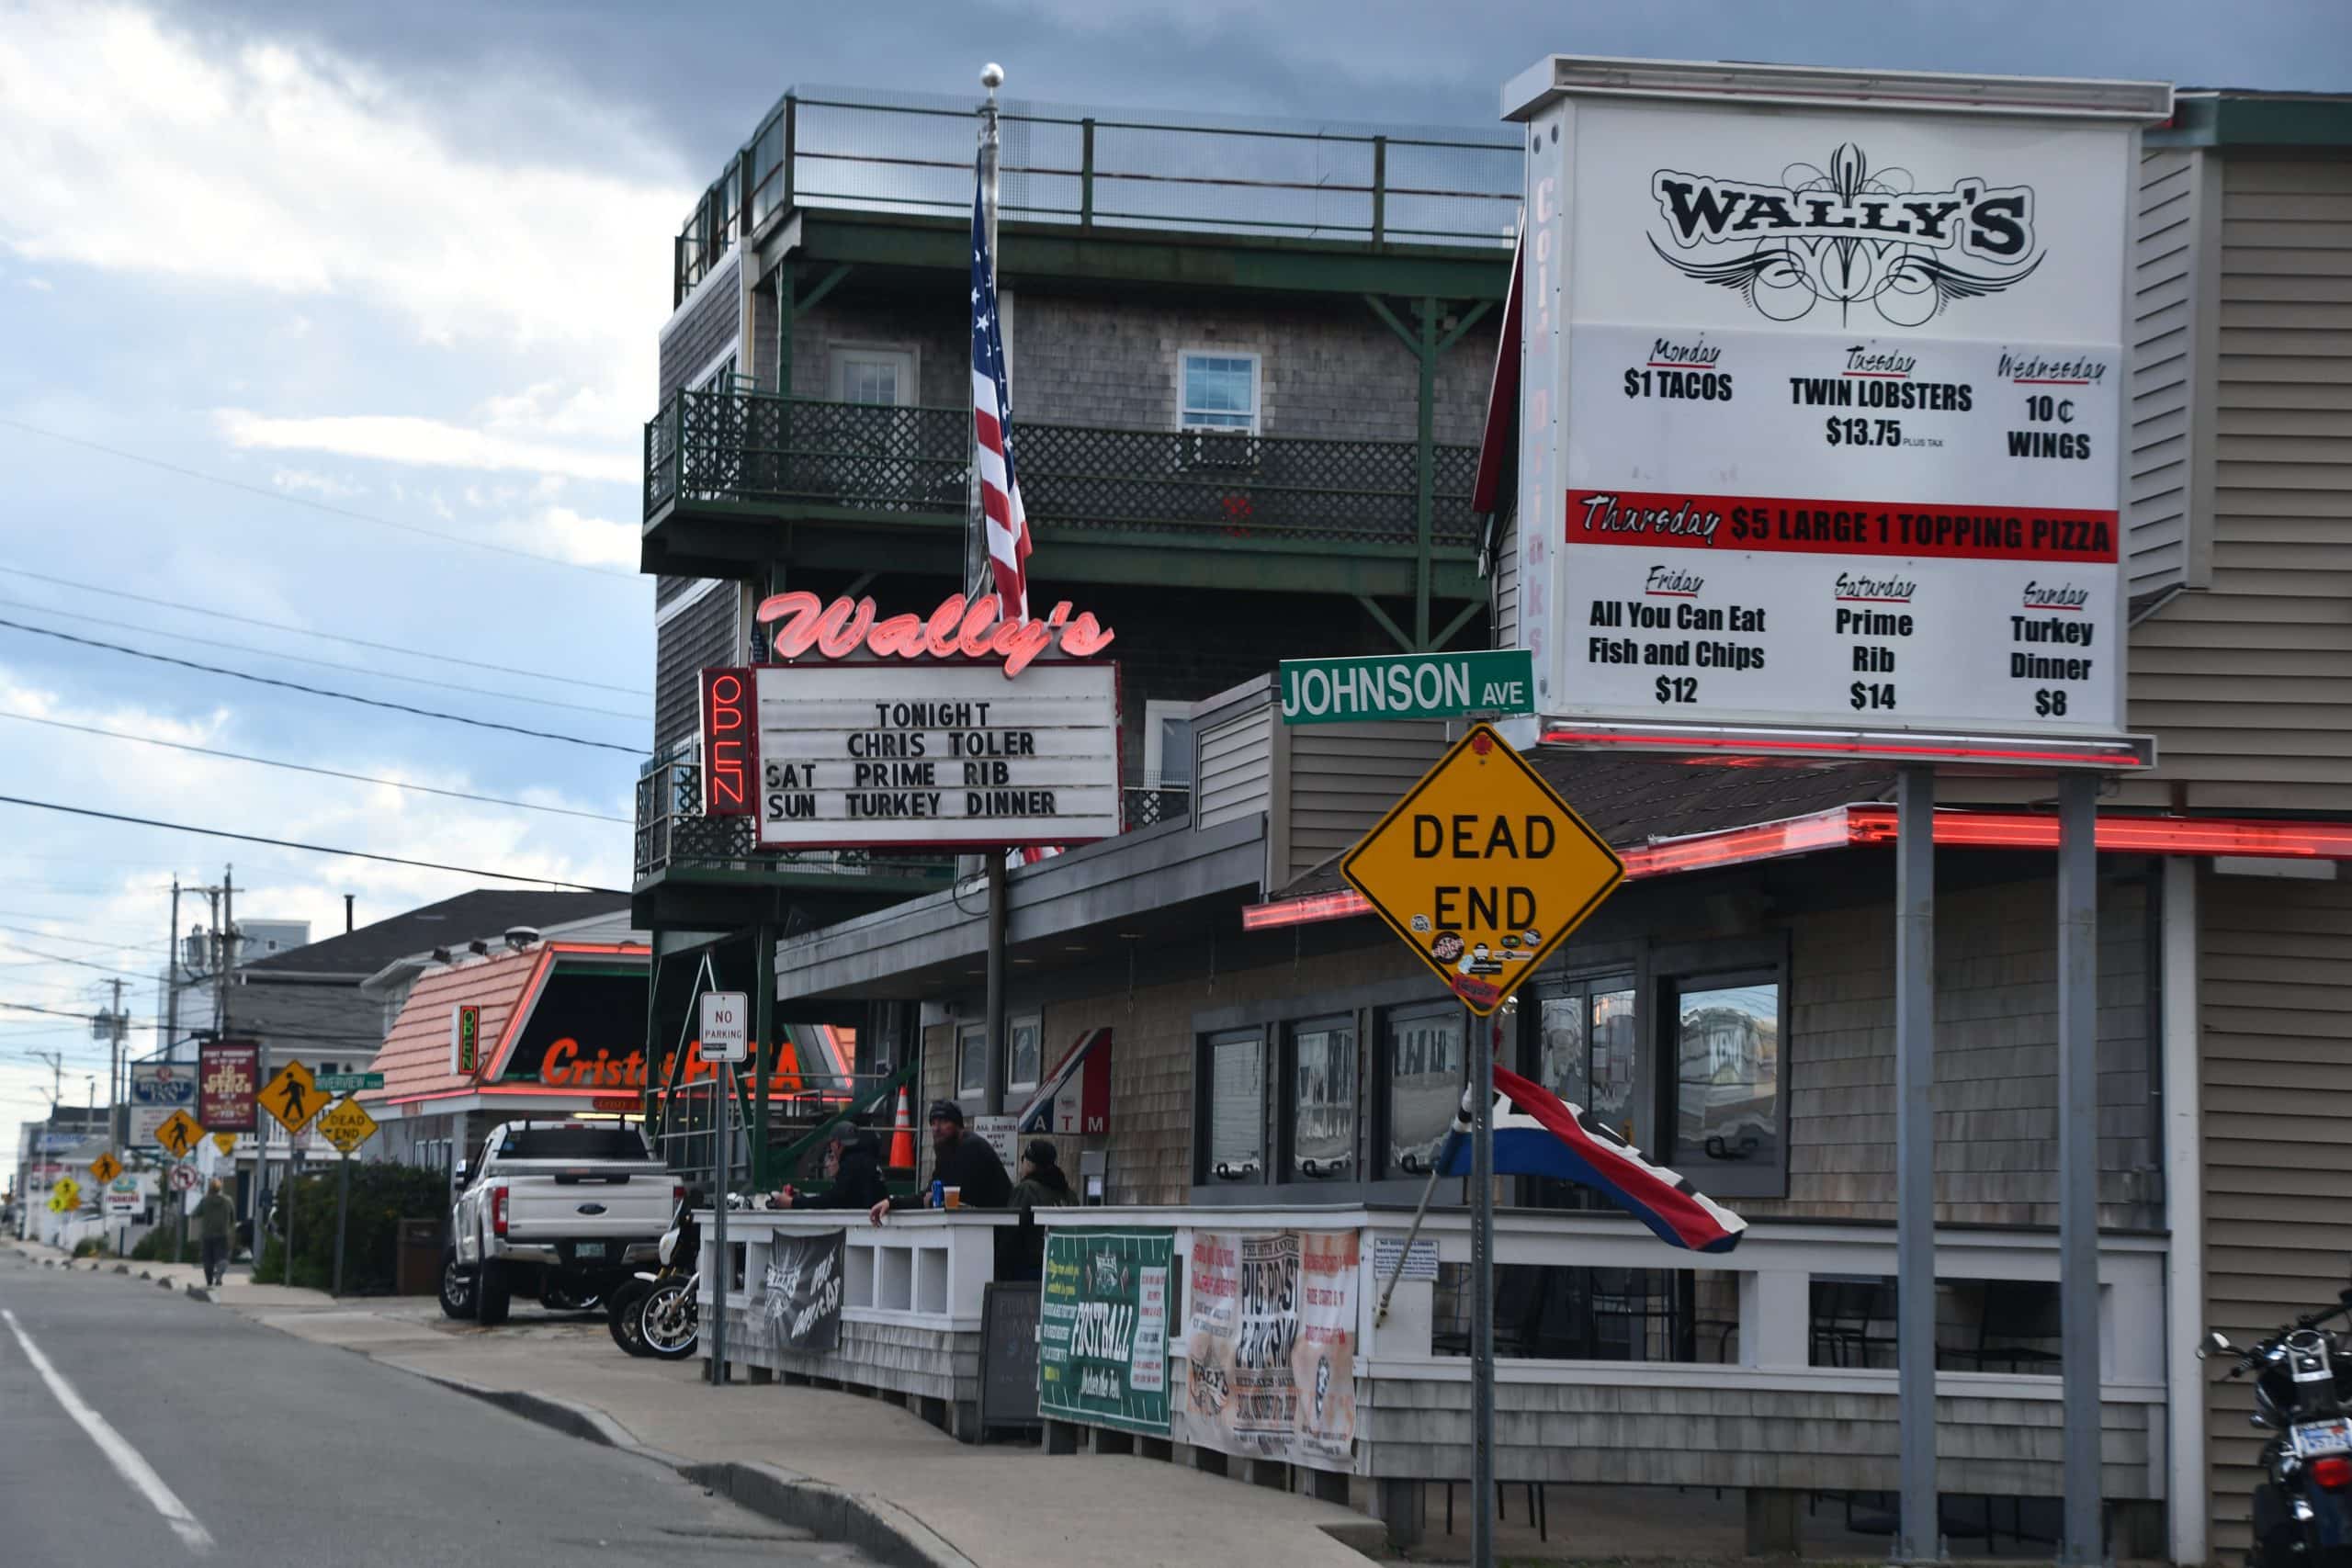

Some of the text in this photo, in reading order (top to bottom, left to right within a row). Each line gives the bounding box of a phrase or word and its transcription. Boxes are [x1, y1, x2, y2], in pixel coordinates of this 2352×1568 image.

[1661, 179, 2025, 255] WALLY'S
[1648, 336, 1721, 368] Monday
[1846, 344, 1917, 378] Tuesday
[1623, 367, 1733, 401] $1 TACOS
[1996, 352, 2107, 385] Wednesday
[1790, 378, 1973, 412] TWIN LOBSTERS
[1826, 415, 1944, 447] $13.75 PLUS TAX
[2007, 430, 2091, 460] WINGS
[1581, 491, 2110, 552] Thursday $5 LARGE 1 TOPPING PIZZA
[1645, 565, 1704, 598] Friday
[1834, 571, 1917, 603] Saturday
[2023, 581, 2088, 611] Sunday
[1589, 600, 1767, 633] All You Can Eat
[1836, 608, 1914, 637] Prime
[2010, 615, 2094, 646] Turkey
[756, 590, 1116, 680] Wally's
[1589, 637, 1765, 671] Fish and Chips
[1852, 646, 1895, 673] Rib
[2010, 652, 2093, 681] Dinner
[1282, 662, 1525, 717] JOHNSON AVE
[1655, 674, 1699, 705] $12
[1849, 681, 1897, 711] $14
[2034, 687, 2067, 717] $8
[876, 702, 990, 728] TONIGHT
[712, 675, 743, 806] OPEN
[846, 731, 1035, 758] CHRIS TOLER
[765, 761, 1010, 789] SAT PRIME RIB
[767, 791, 1056, 818] SUN TURKEY DINNER
[1413, 814, 1555, 859] DEAD
[1434, 886, 1537, 931] END
[715, 1010, 733, 1024] NO
[705, 1029, 742, 1039] PARKING
[315, 1075, 365, 1090] RIVERVIEW
[331, 1114, 366, 1125] DEAD
[334, 1127, 360, 1139] END
[1034, 1115, 1103, 1133] ATM
